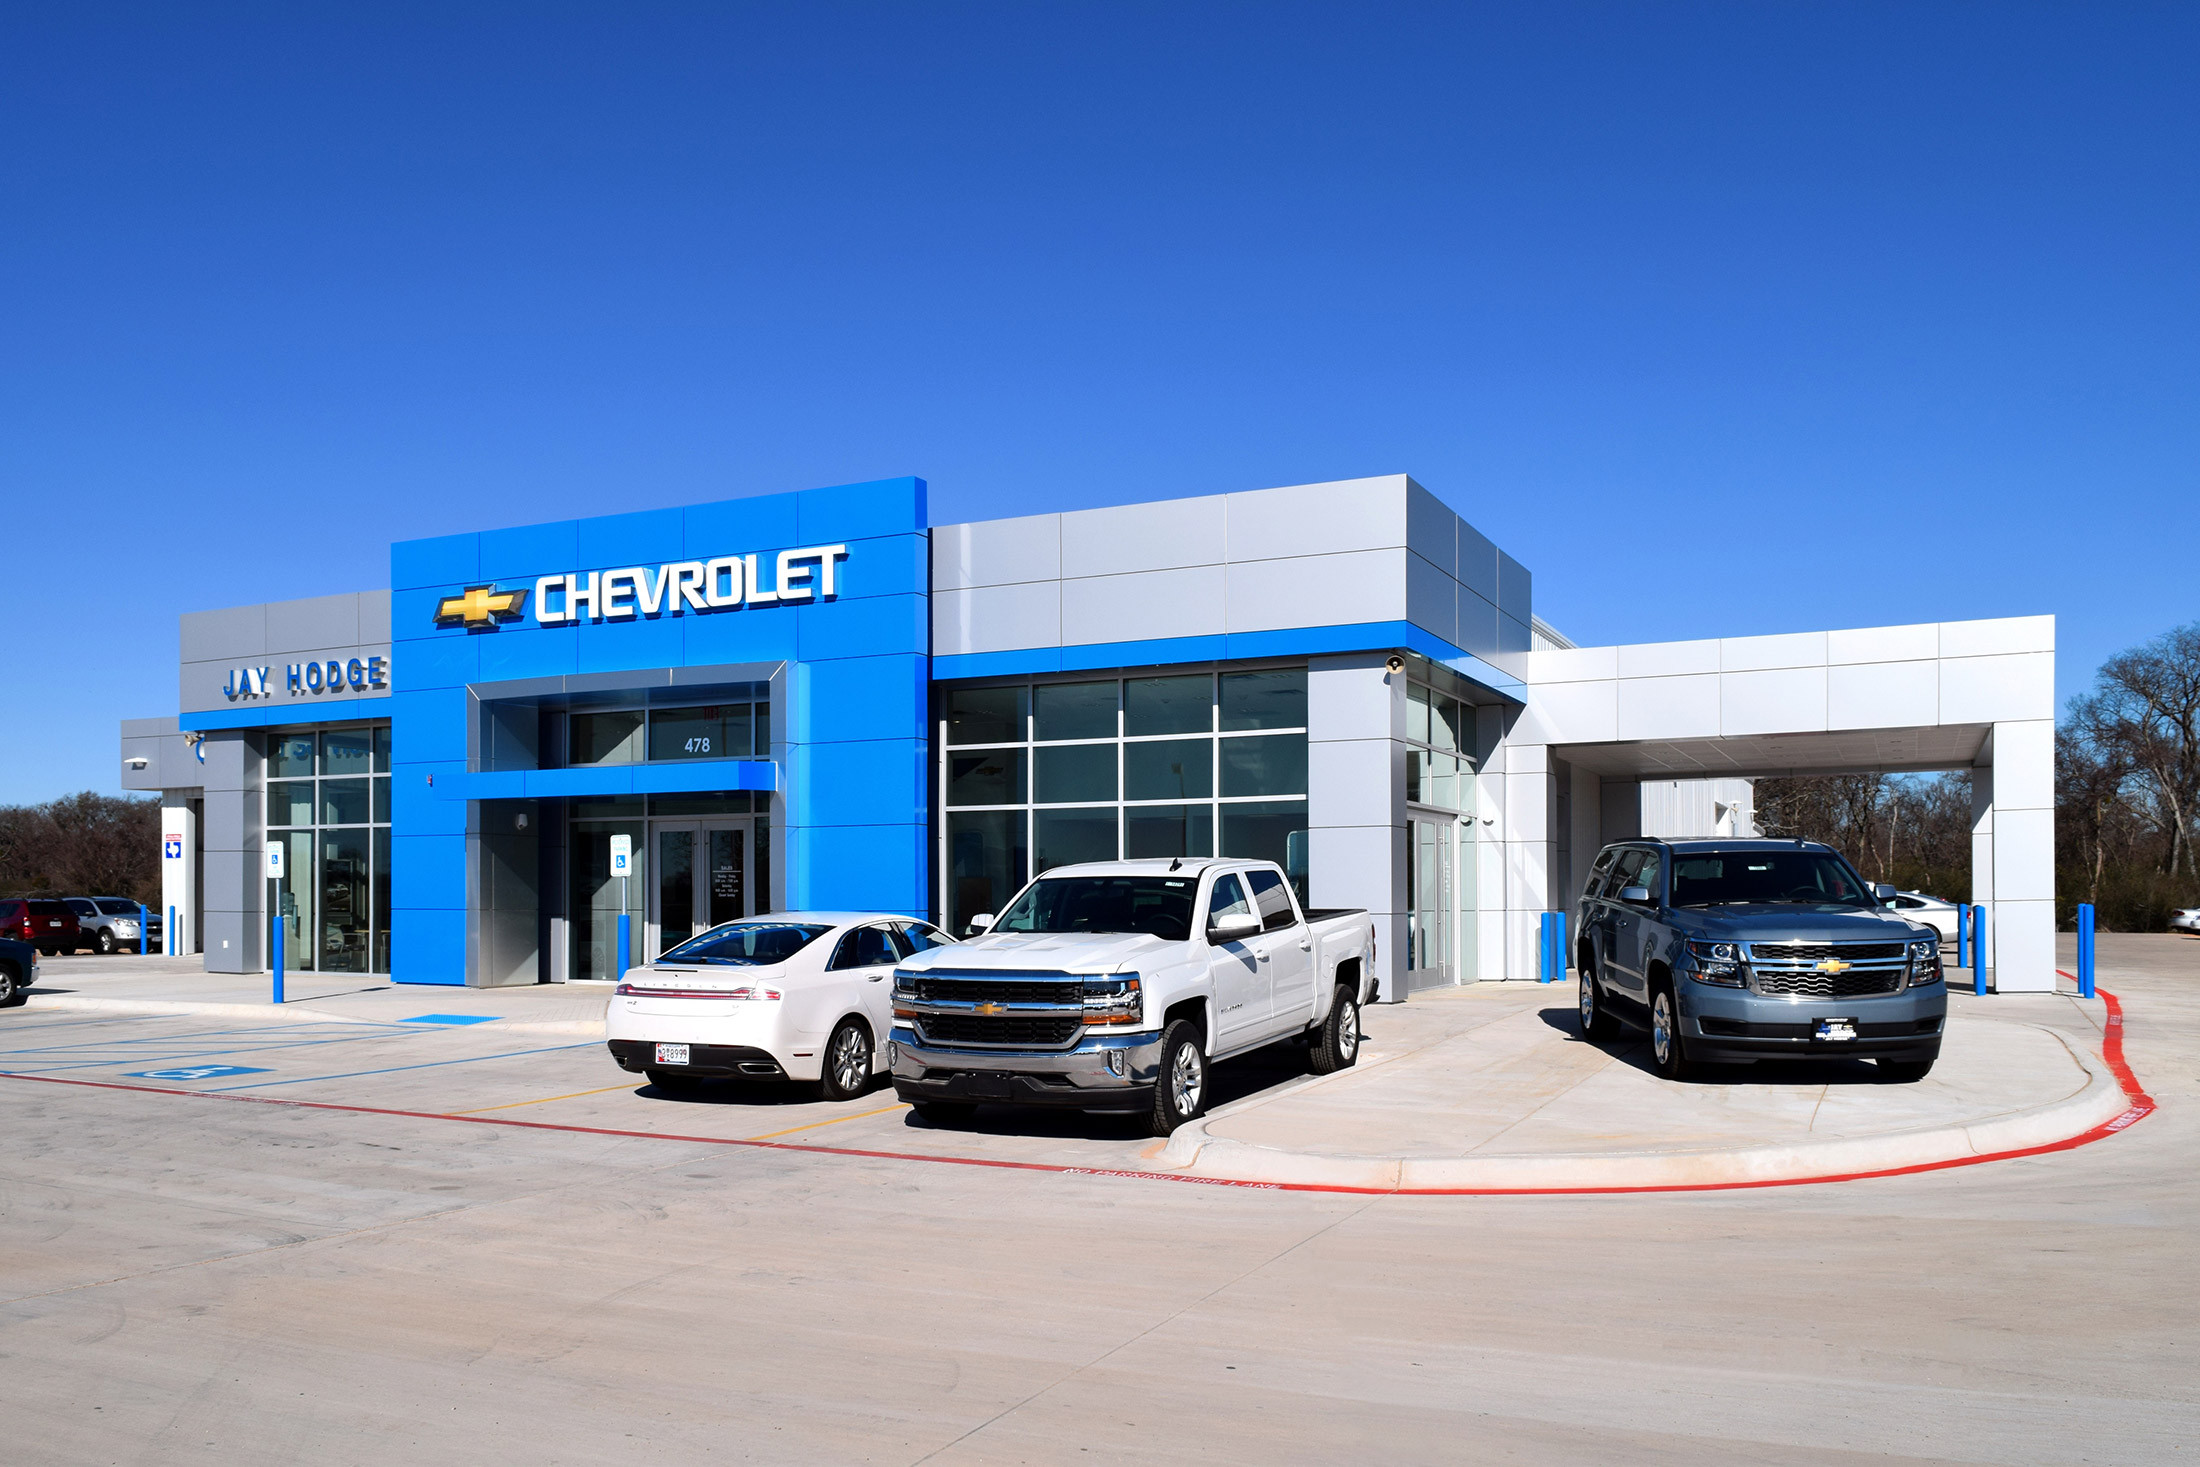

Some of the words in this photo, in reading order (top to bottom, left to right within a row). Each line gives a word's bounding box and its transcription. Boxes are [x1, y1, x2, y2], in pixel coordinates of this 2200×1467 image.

[535, 544, 847, 623] CHEVROLET
[223, 667, 273, 697] JAY
[287, 656, 385, 691] HODGE
[684, 737, 711, 753] 478
